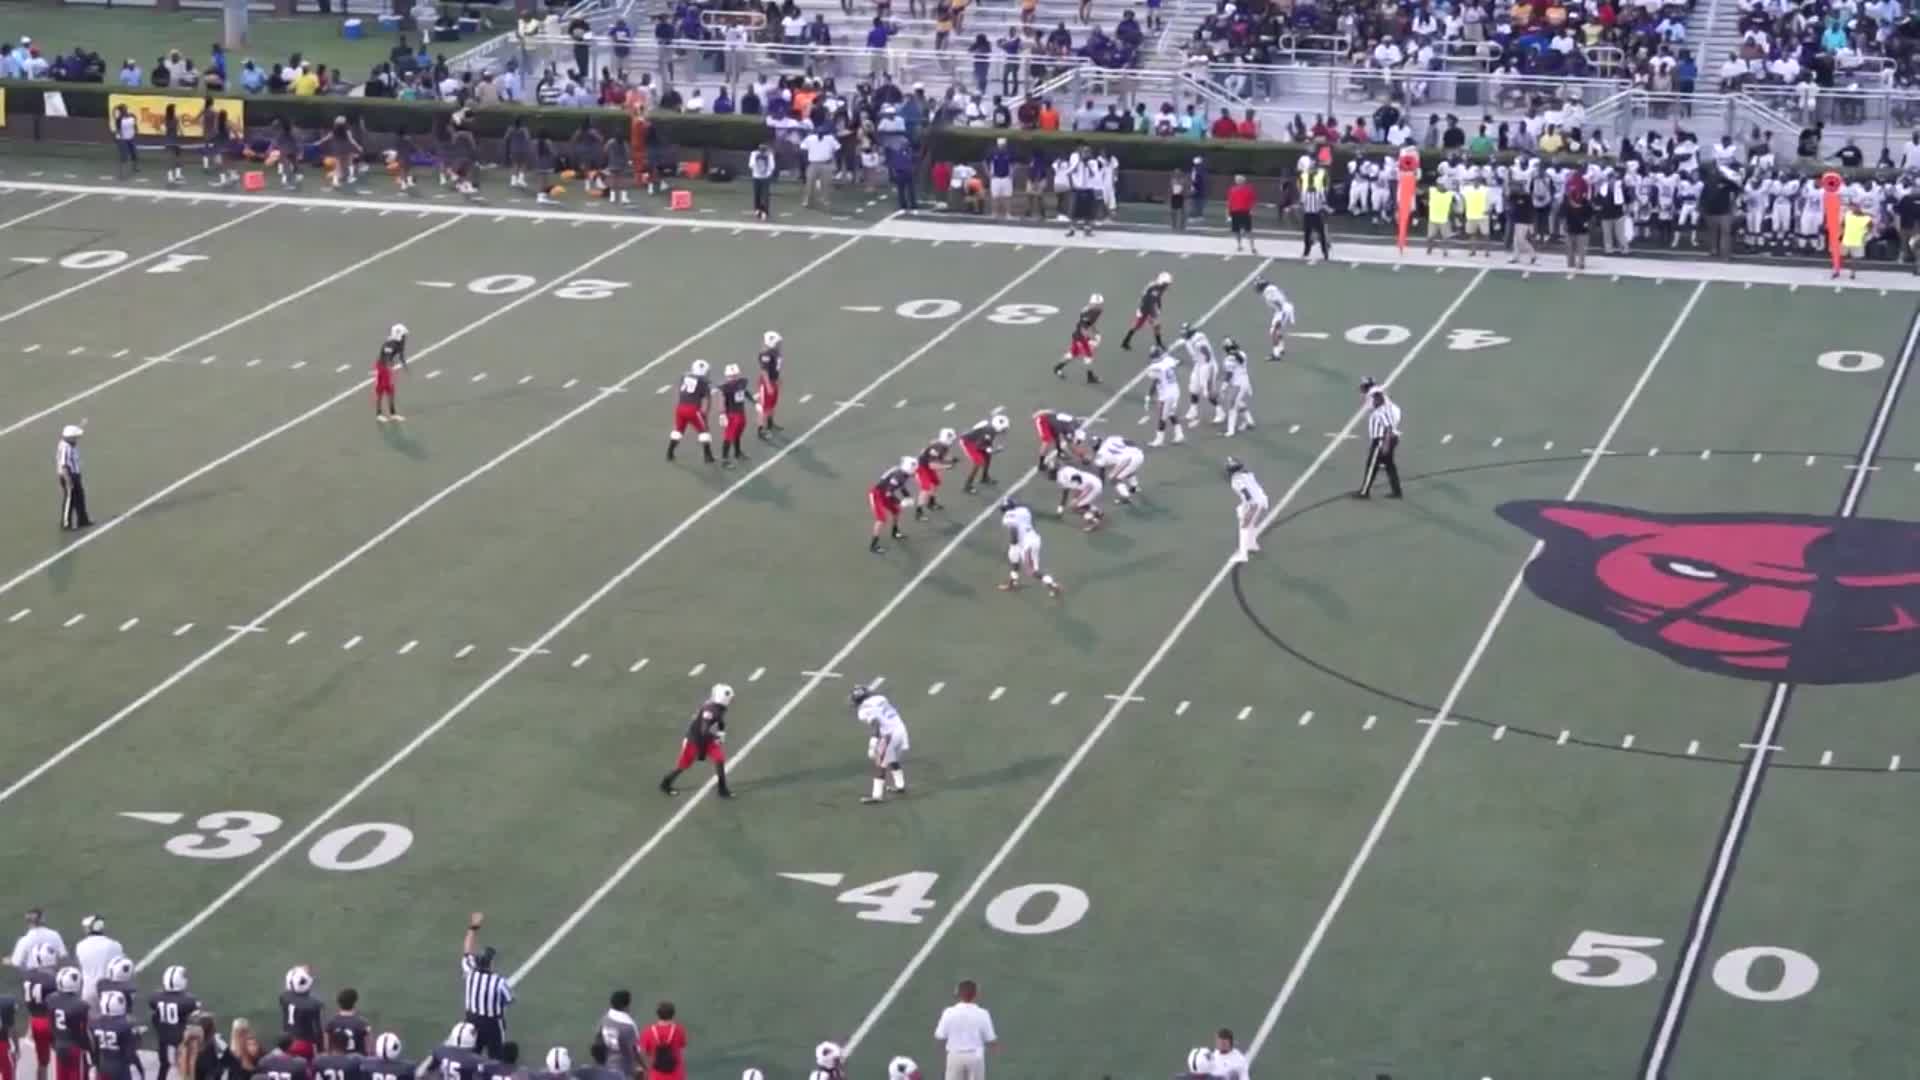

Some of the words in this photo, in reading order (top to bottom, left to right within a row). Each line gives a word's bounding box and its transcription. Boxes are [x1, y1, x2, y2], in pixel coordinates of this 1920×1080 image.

[60, 251, 208, 272] 10
[468, 275, 631, 299] 20
[896, 299, 1060, 324] 30
[1345, 325, 1511, 349] 40
[165, 811, 414, 871] 30
[836, 871, 1090, 934] 40
[1551, 930, 1820, 1001] 50
[23, 980, 42, 1003] 14
[55, 1008, 67, 1030] 2
[157, 1001, 179, 1024] 10
